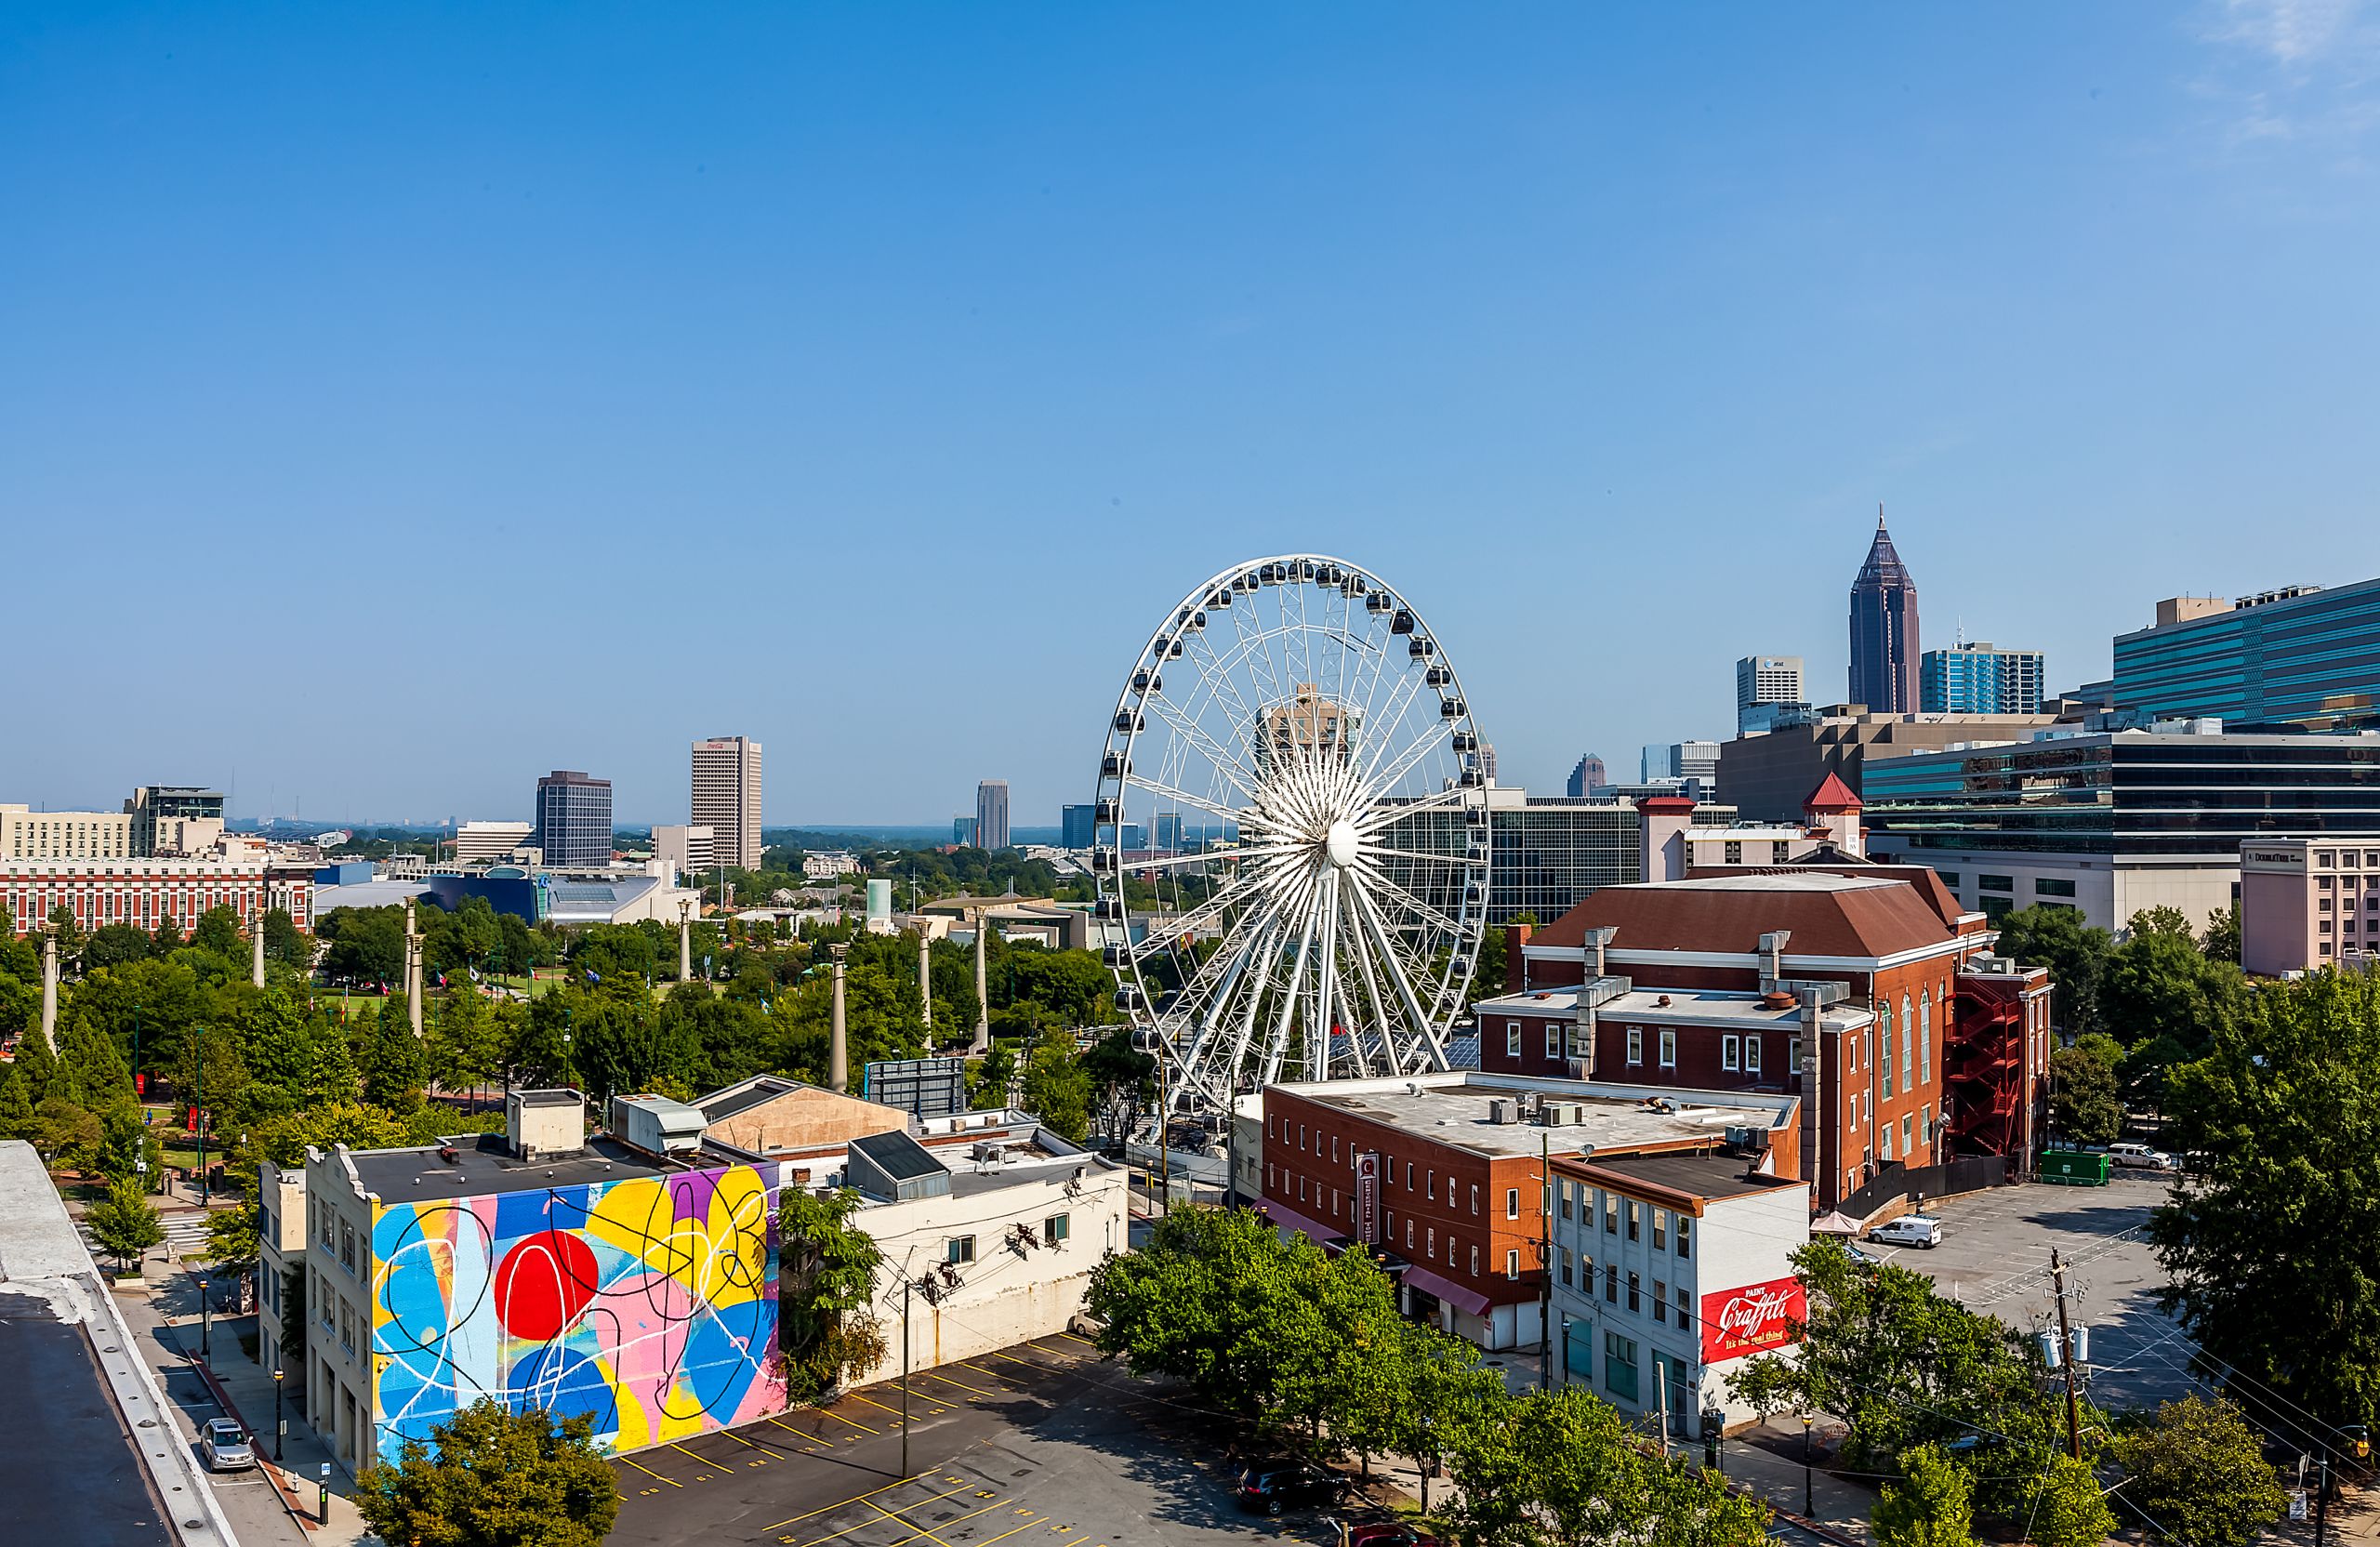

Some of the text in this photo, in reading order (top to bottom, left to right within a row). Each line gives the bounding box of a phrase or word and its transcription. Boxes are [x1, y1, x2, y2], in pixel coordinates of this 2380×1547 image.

[1364, 1162, 1371, 1172] C
[1745, 1287, 1766, 1298] PAINT
[1714, 1289, 1799, 1344] Graffiti
[1726, 1340, 1737, 1350] It's
[1752, 1332, 1765, 1343] real
[1765, 1329, 1783, 1341] thing
